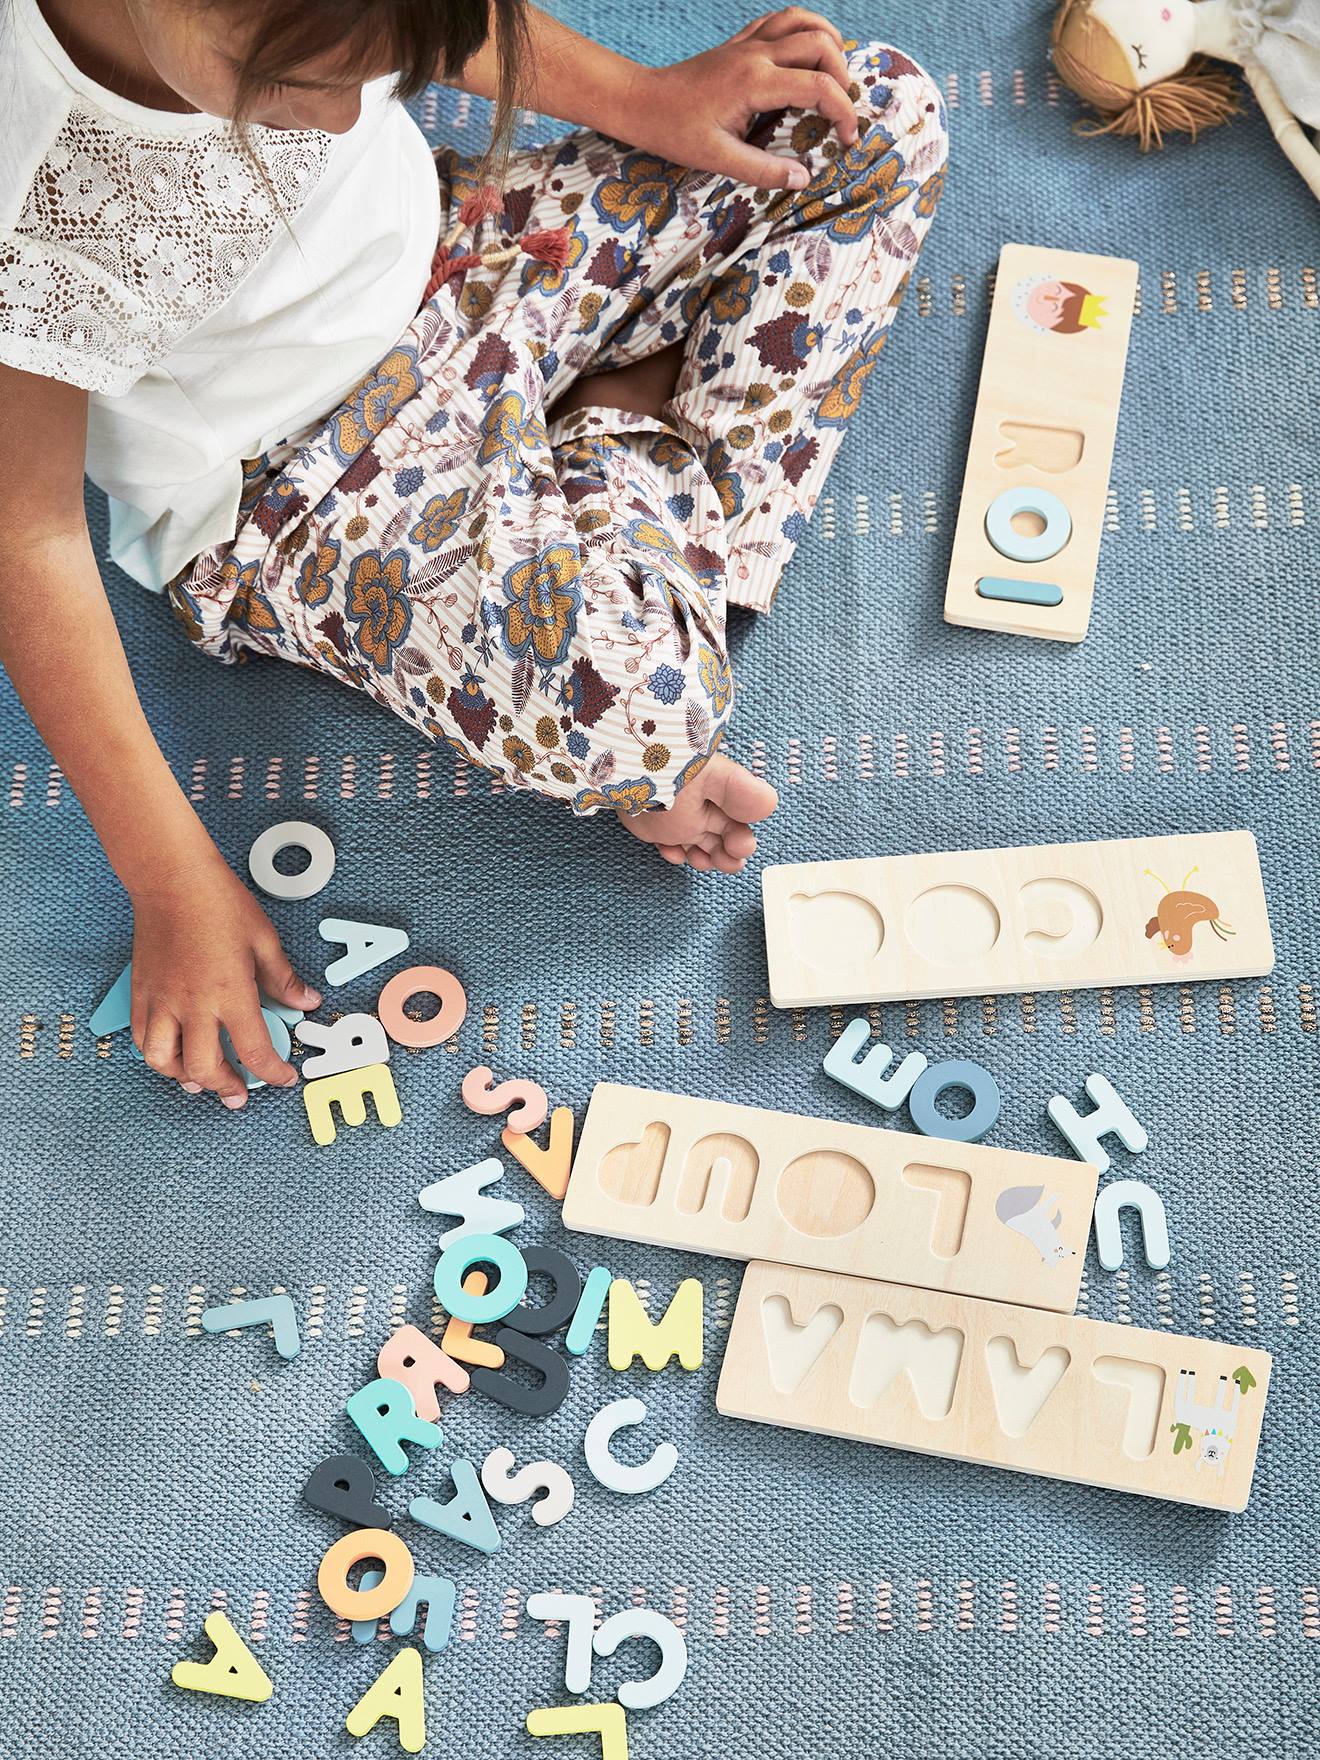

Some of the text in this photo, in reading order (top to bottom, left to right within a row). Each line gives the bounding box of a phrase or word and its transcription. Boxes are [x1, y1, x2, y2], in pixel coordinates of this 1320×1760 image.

[249, 821, 336, 900] O
[318, 917, 410, 986] A
[378, 966, 467, 1047] O
[303, 1063, 402, 1146] E
[462, 1066, 548, 1134] S
[824, 1018, 927, 1112] E
[1047, 1073, 1149, 1174] H
[597, 1120, 973, 1260] LOUP
[608, 1278, 704, 1371] M
[761, 1294, 1166, 1461] LAMA
[347, 1378, 443, 1476] R
[584, 1399, 679, 1494] C
[408, 1459, 502, 1554] A
[482, 1447, 575, 1526] S
[318, 1528, 415, 1621] O
[172, 1611, 273, 1702] A
[346, 1647, 425, 1753] A
